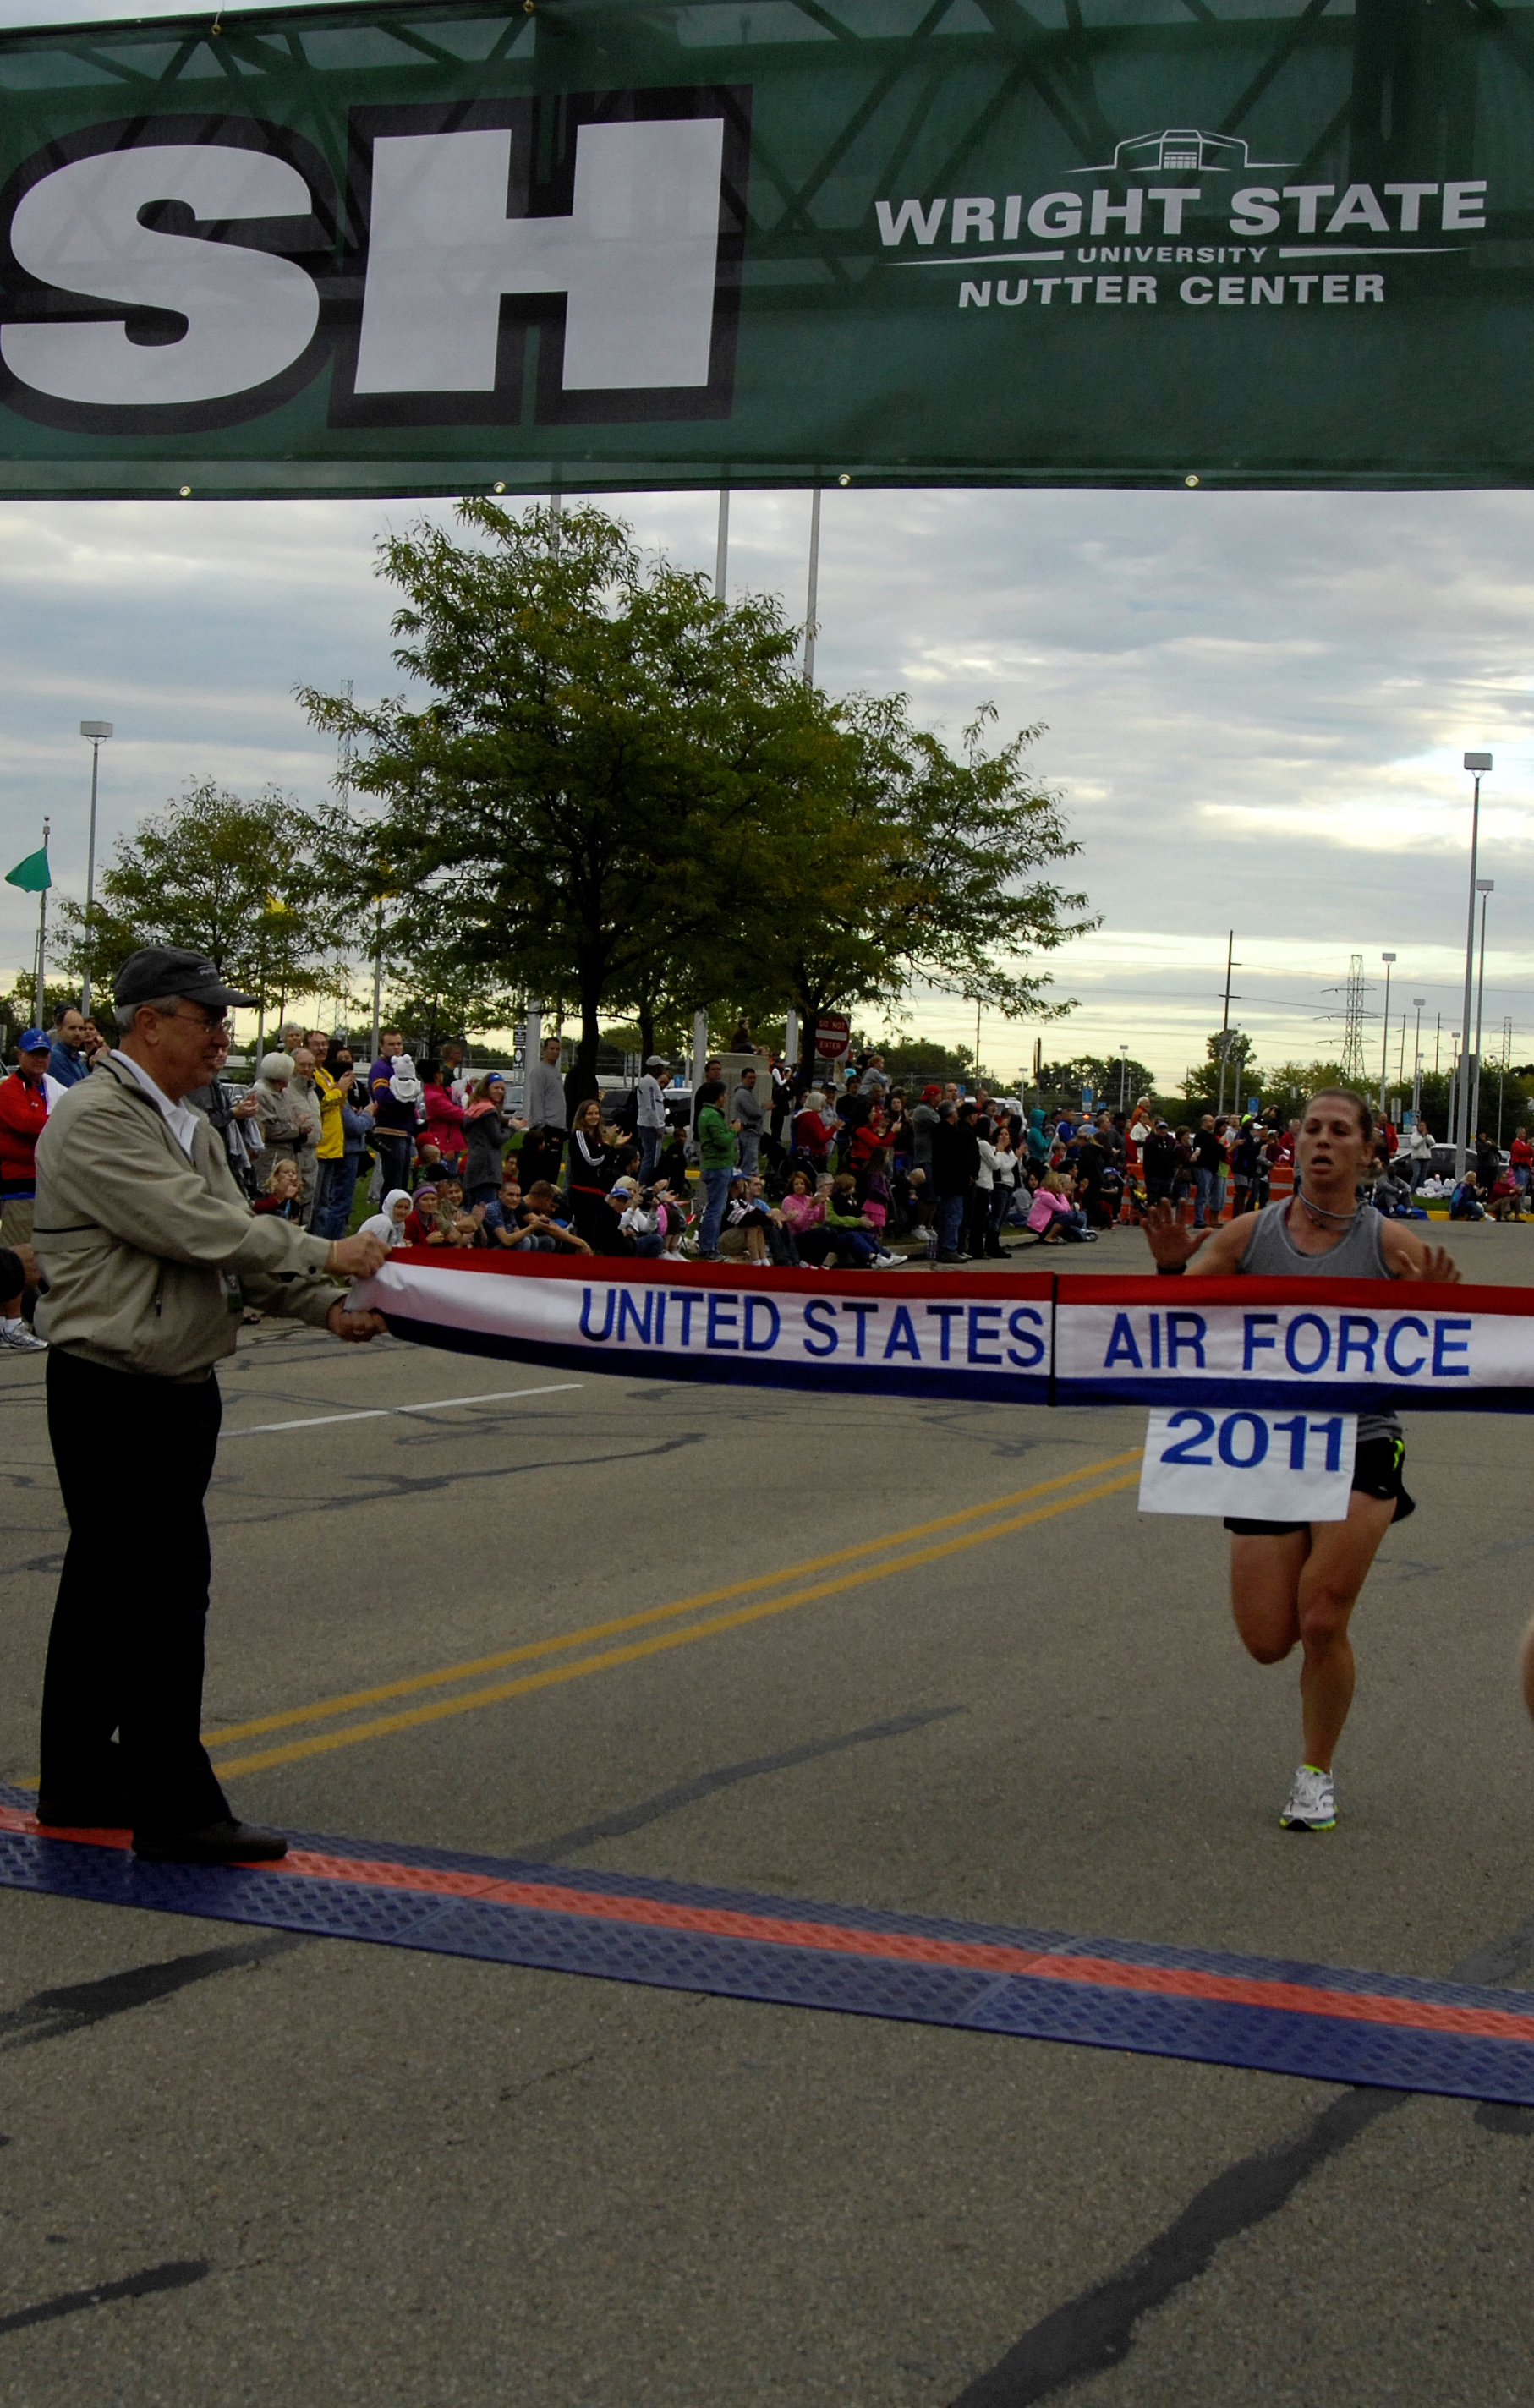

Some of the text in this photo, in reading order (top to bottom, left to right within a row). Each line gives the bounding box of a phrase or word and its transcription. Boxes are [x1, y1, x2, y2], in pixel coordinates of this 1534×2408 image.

[874, 180, 1487, 246] WRIGHT STATE
[1, 118, 724, 405] SH
[1077, 246, 1267, 264] UNIVERSITY
[958, 275, 1383, 308] NUTTER CENTER
[819, 1020, 845, 1030] DO NOT
[819, 1040, 841, 1050] ENTER
[580, 1288, 1473, 1377] UNITED STATES AIR FORCE
[1159, 1409, 1345, 1472] 2011
